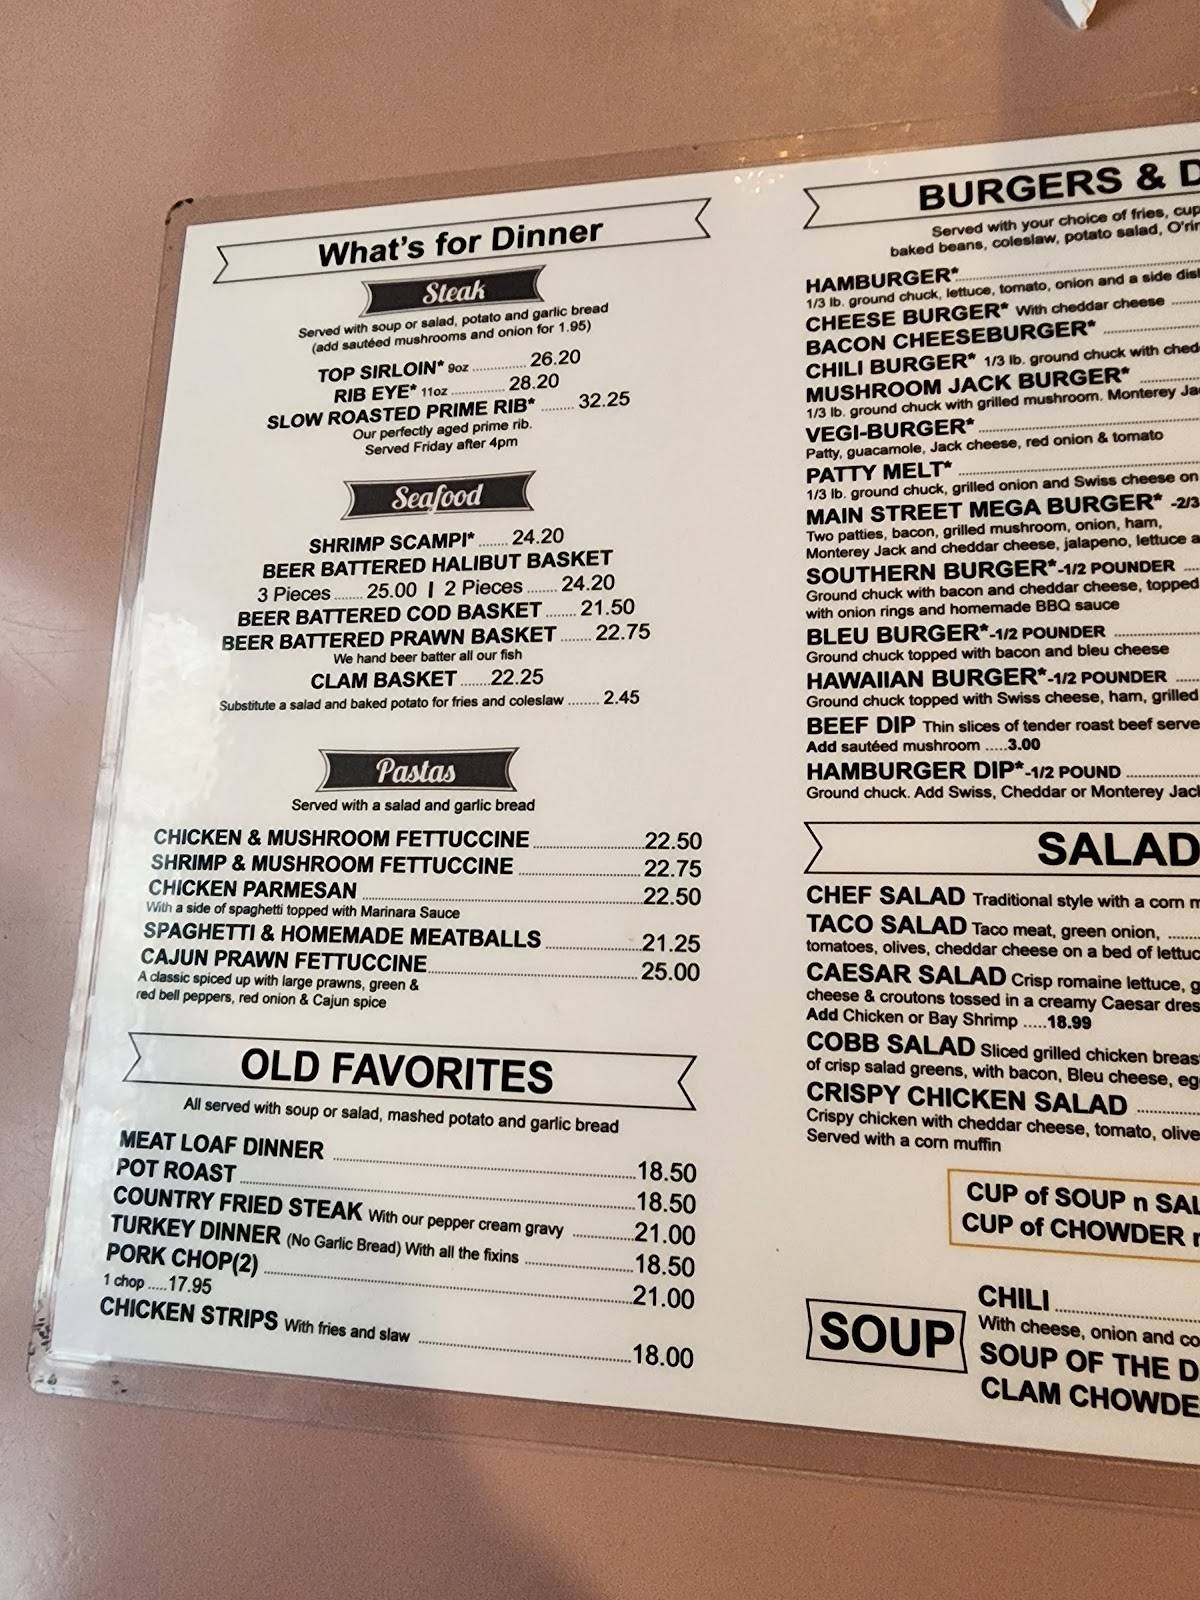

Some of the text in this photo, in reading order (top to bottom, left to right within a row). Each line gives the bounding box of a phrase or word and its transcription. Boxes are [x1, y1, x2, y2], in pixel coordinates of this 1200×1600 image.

[919, 162, 1166, 211] BURGERS &
[318, 222, 604, 267] What's for Dinner
[422, 280, 485, 303] Steak
[805, 310, 896, 333] CHEESE
[1015, 304, 1048, 316] With
[1051, 300, 1109, 314] cheddar
[1112, 297, 1165, 310] cheese
[806, 335, 886, 356] BACON
[318, 367, 355, 383] TOP
[448, 363, 469, 373] 9oz
[530, 349, 581, 367] 26.20
[334, 387, 366, 404] RIB
[421, 387, 448, 397] 11oz
[509, 373, 559, 391] 28.20
[806, 379, 942, 403] MUSHROOM
[948, 374, 1012, 394] JACK
[267, 412, 324, 430] SLOW
[327, 405, 421, 426] ROASTED
[426, 400, 488, 419] PRIME
[578, 391, 630, 409] 32.25
[364, 437, 518, 456] Served Friday after 4pm
[806, 429, 1164, 461] Patty, guacamole, Jack cheese, red onion & tomato
[806, 464, 877, 484] PATTY
[390, 484, 484, 512] Seafood
[309, 536, 385, 554] SHRIMP
[512, 527, 564, 546] 24.20
[806, 517, 1162, 544] Two patties, bacon, grilled mushroom, onion, ham,
[262, 549, 614, 579] BEER BATTERED HALIBUT BASKET
[333, 648, 522, 664] We hand beer batter all our fish
[806, 643, 1170, 663] Ground chuck topped with bacon and bleu cheese
[311, 668, 544, 690] CLAM BASKET 22.25
[806, 737, 1041, 753] Add sautéed mushroom 3.00
[375, 757, 457, 784] Pastas
[291, 798, 535, 815] Served with a salad and garlic bread
[154, 828, 702, 850] CHICKEN & MUSHROOM FETTUCCINE 22.50
[149, 879, 702, 906] CHICKEN PARMESAN 22.50
[144, 921, 701, 953] SPAGHETTI & HOMEMADE MEATBALLS 21.25
[806, 913, 1160, 941] TACO SALAD Taco meat, green onion,
[141, 947, 700, 982] CAJUN PRAWN FETTUCCINE 25.00
[241, 1048, 553, 1095] OLD FAVORITES
[806, 1081, 1128, 1116] CRISPY CHICKEN SALAD
[807, 1128, 1001, 1152] Served with a corn muffin
[119, 1130, 697, 1183] MEAT LOAF DINNER 18.50
[116, 1158, 696, 1215] POT ROAST 18.50
[113, 1185, 696, 1246] COUNTRY FRIED STEAK With our pepper cream gravy 21.00
[106, 1242, 695, 1310] PORK CHOP(2) 21.00
[978, 1284, 1049, 1312] CHILI
[100, 1296, 694, 1369] CHICKEN STRIPS With fries and slaw 18.00
[819, 1311, 955, 1358] SOUP
